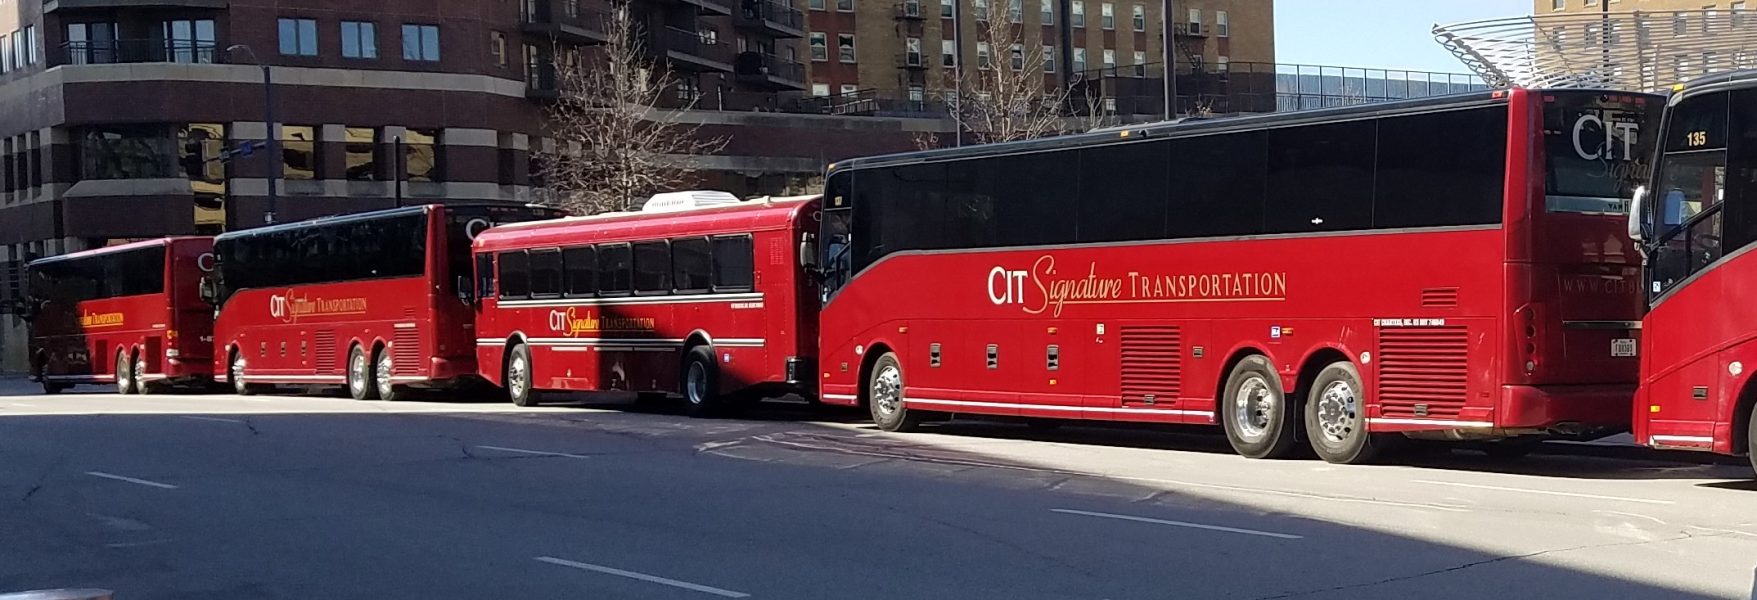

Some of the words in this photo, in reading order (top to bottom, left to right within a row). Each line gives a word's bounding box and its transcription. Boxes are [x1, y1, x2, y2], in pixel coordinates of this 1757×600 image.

[1572, 114, 1639, 160] CIT
[1687, 131, 1706, 146] 135
[988, 266, 1028, 304] CIT
[1022, 255, 1122, 318] Signature
[1128, 271, 1286, 298] TRANSPORTATION
[270, 294, 285, 317] CIT
[549, 309, 566, 331] CIT
[563, 306, 600, 338] Signature
[601, 315, 655, 329] TRANSPORTATION
